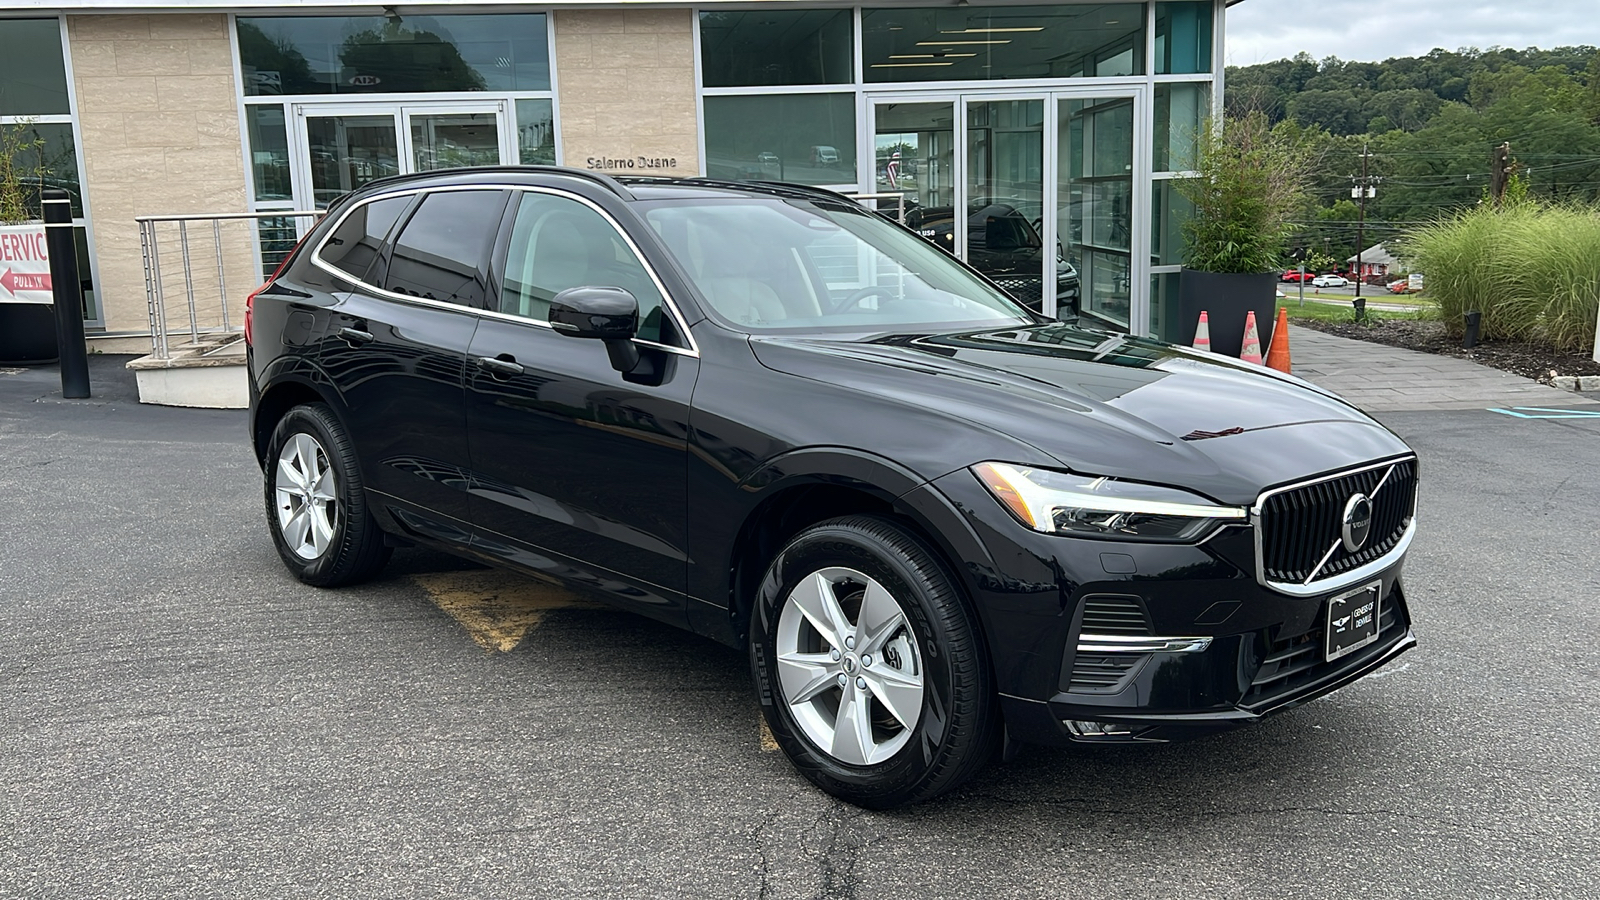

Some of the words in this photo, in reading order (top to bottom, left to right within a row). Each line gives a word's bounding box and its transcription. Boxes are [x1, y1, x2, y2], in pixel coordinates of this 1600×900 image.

[587, 157, 634, 169] Salerno
[638, 156, 677, 169] Duane
[0, 232, 48, 261] ERVIC
[13, 276, 33, 288] PULL
[905, 590, 939, 658] ZERO
